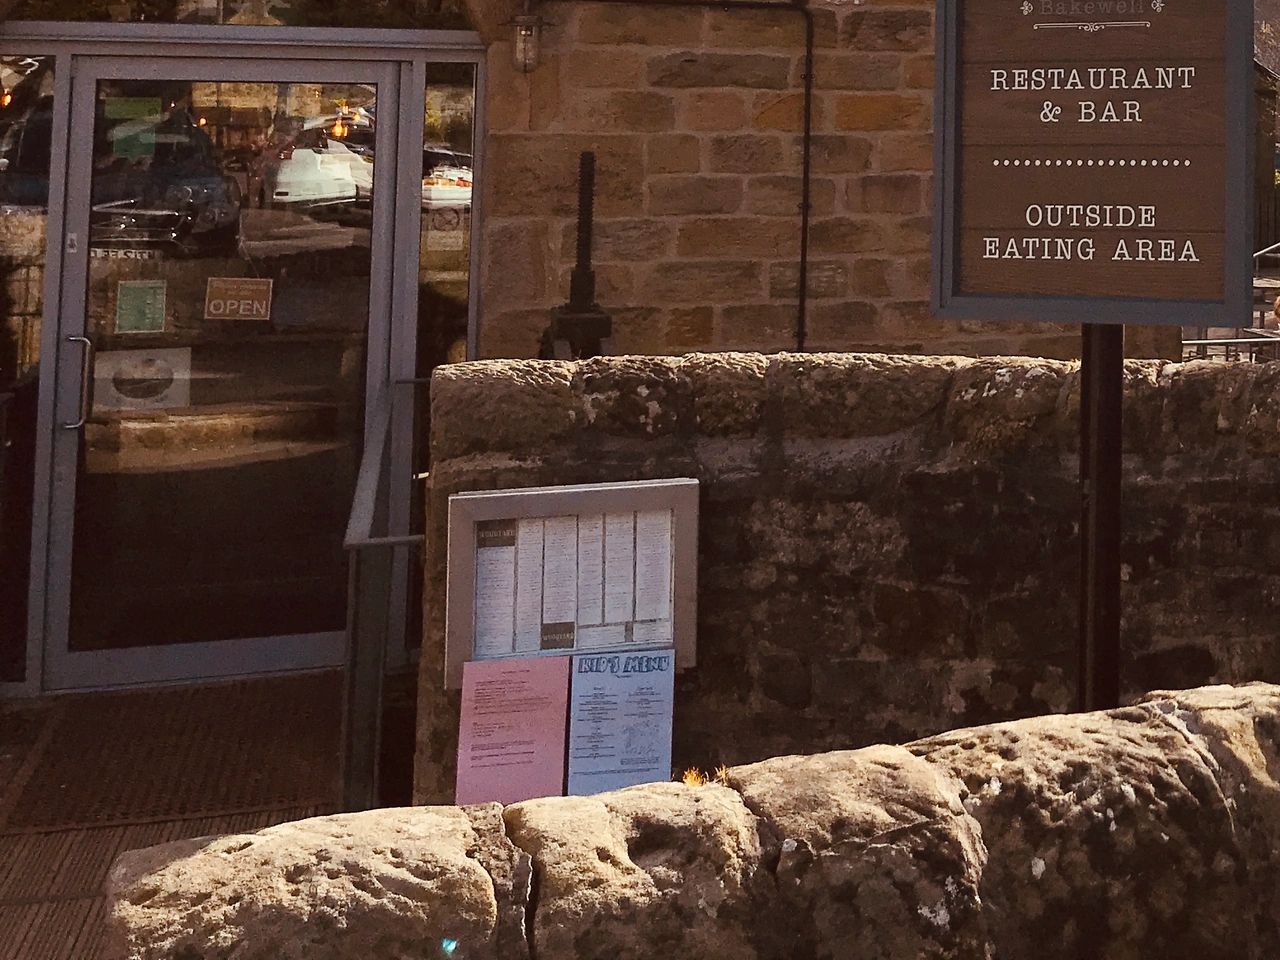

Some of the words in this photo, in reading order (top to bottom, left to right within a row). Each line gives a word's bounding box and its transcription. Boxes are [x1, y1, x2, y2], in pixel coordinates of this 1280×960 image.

[990, 67, 1196, 90] RESTAURANT
[1040, 102, 1062, 123] &
[1078, 101, 1143, 123] BAR
[1025, 205, 1156, 228] OUTSIDE
[983, 237, 1096, 260] EATING
[1112, 240, 1200, 262] AREA
[210, 300, 266, 315] OPEN
[623, 655, 670, 672] MENU
